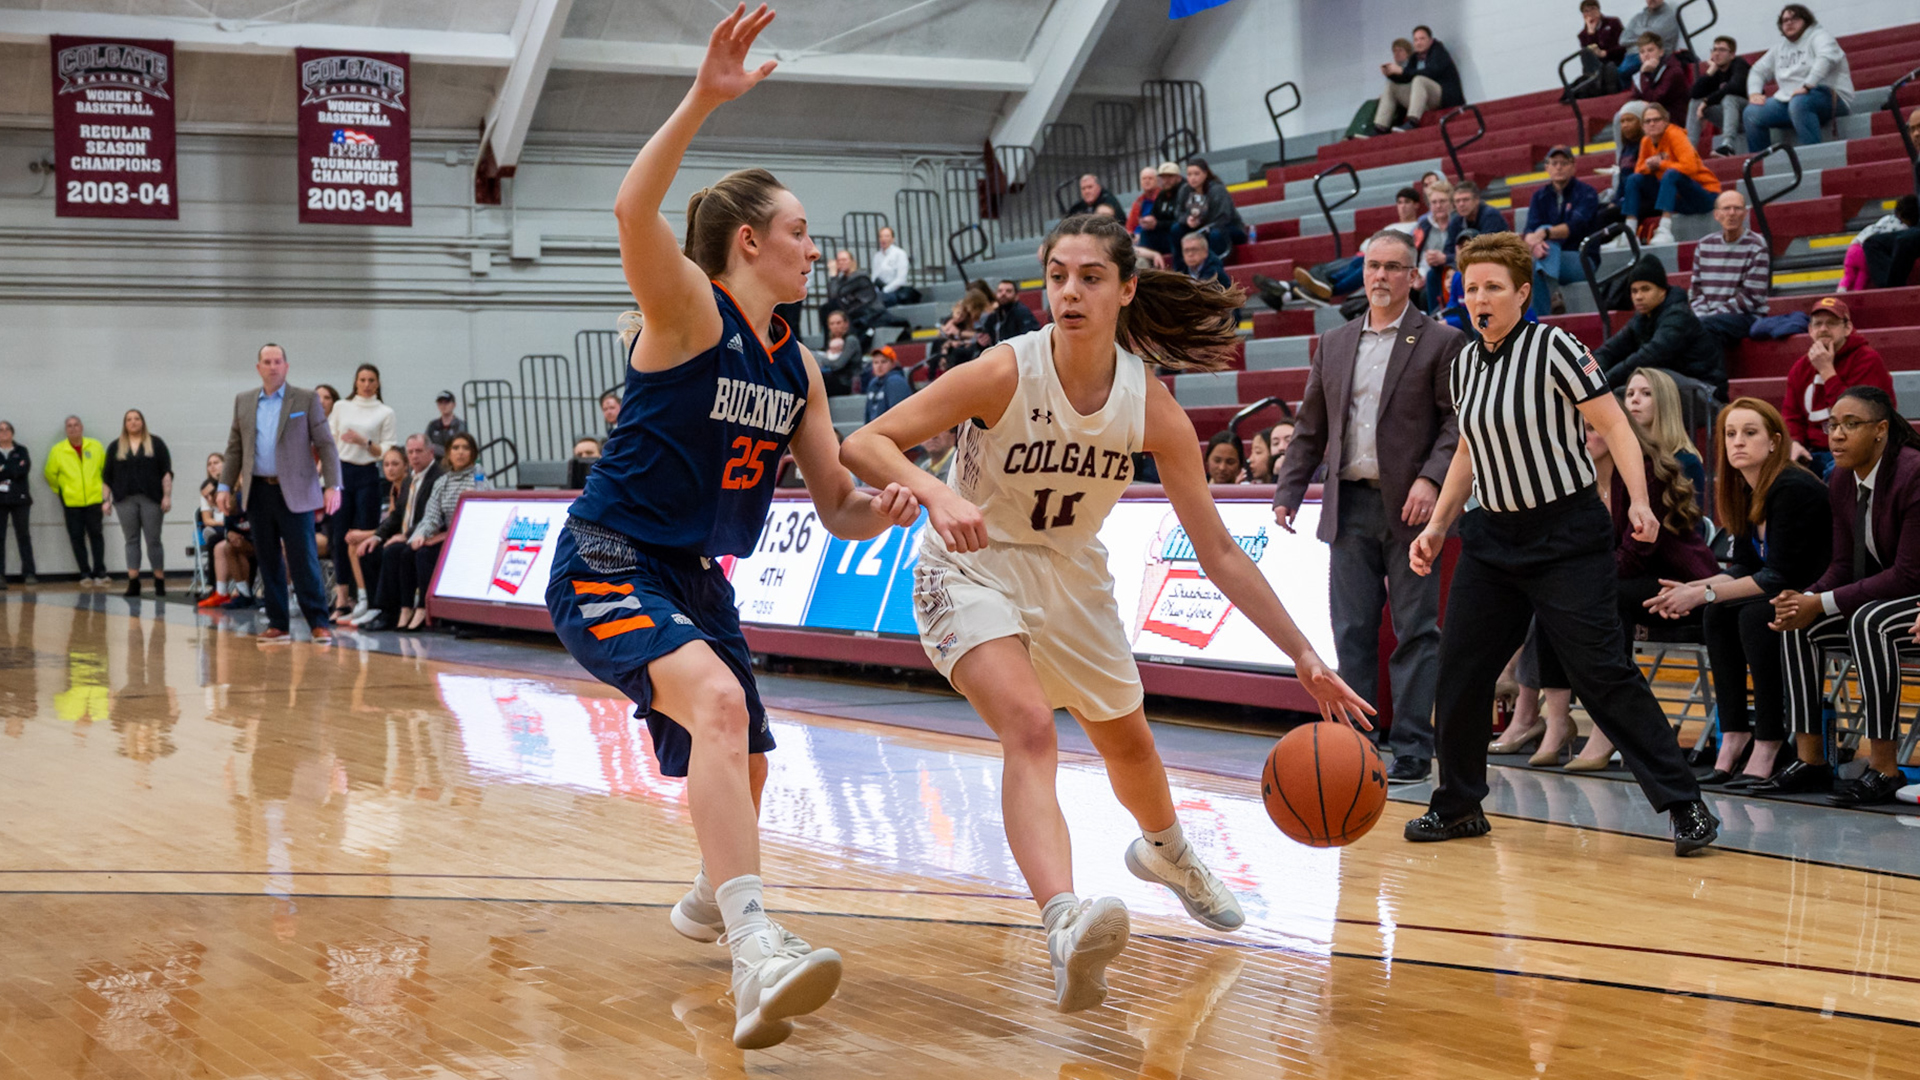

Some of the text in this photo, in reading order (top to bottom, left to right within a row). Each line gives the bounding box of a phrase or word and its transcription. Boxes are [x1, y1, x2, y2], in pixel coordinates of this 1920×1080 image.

[61, 46, 166, 77] COLGATE
[305, 58, 403, 89] COLGATE
[86, 89, 143, 102] WOMEN'S
[75, 101, 154, 115] BASKETBALL
[327, 100, 381, 113] WOMEN'S
[318, 111, 391, 126] BASKETBALL
[80, 124, 152, 140] REGULAR
[86, 140, 146, 156] SEASON
[70, 156, 162, 172] CHAMPIONS
[311, 157, 399, 172] TOURNAMENT
[311, 169, 398, 186] CHAMPIONS
[67, 181, 170, 205] 2003-04
[307, 187, 403, 213] 2003-04
[721, 435, 779, 490] 25
[1003, 440, 1130, 481] COLGATE
[1030, 487, 1086, 532] 11
[759, 567, 786, 587] 4TH
